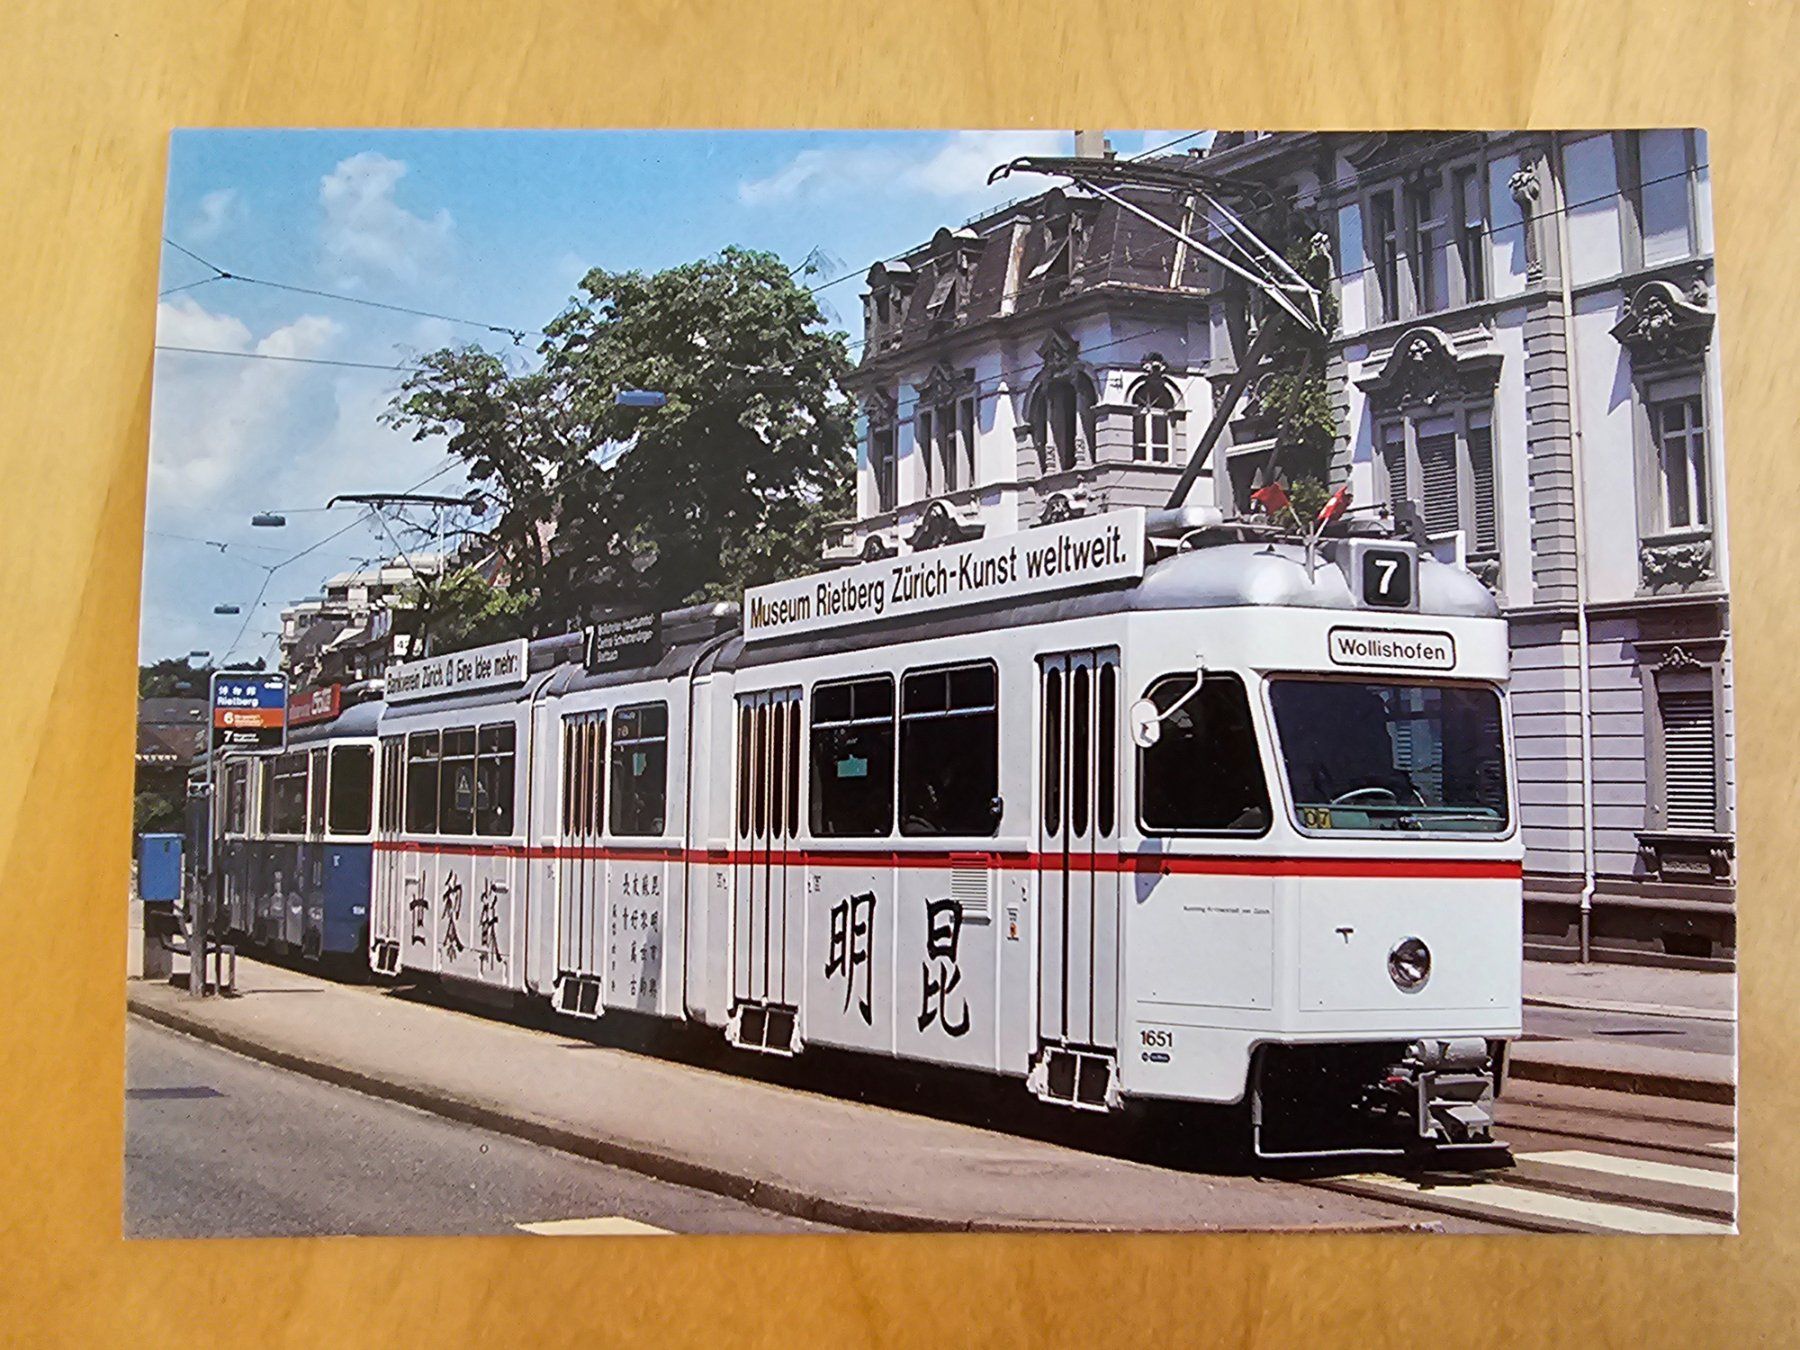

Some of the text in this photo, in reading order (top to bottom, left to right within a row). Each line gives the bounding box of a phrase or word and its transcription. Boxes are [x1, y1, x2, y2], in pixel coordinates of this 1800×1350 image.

[749, 525, 1128, 629] Museum Rietberg Zürich-Kunst weltweit.
[1374, 559, 1398, 596] 7
[1337, 636, 1446, 662] Wollishofen
[217, 696, 259, 708] Rietberg
[223, 711, 234, 725] 6
[223, 730, 234, 743] 7
[1140, 1029, 1173, 1048] 1651
